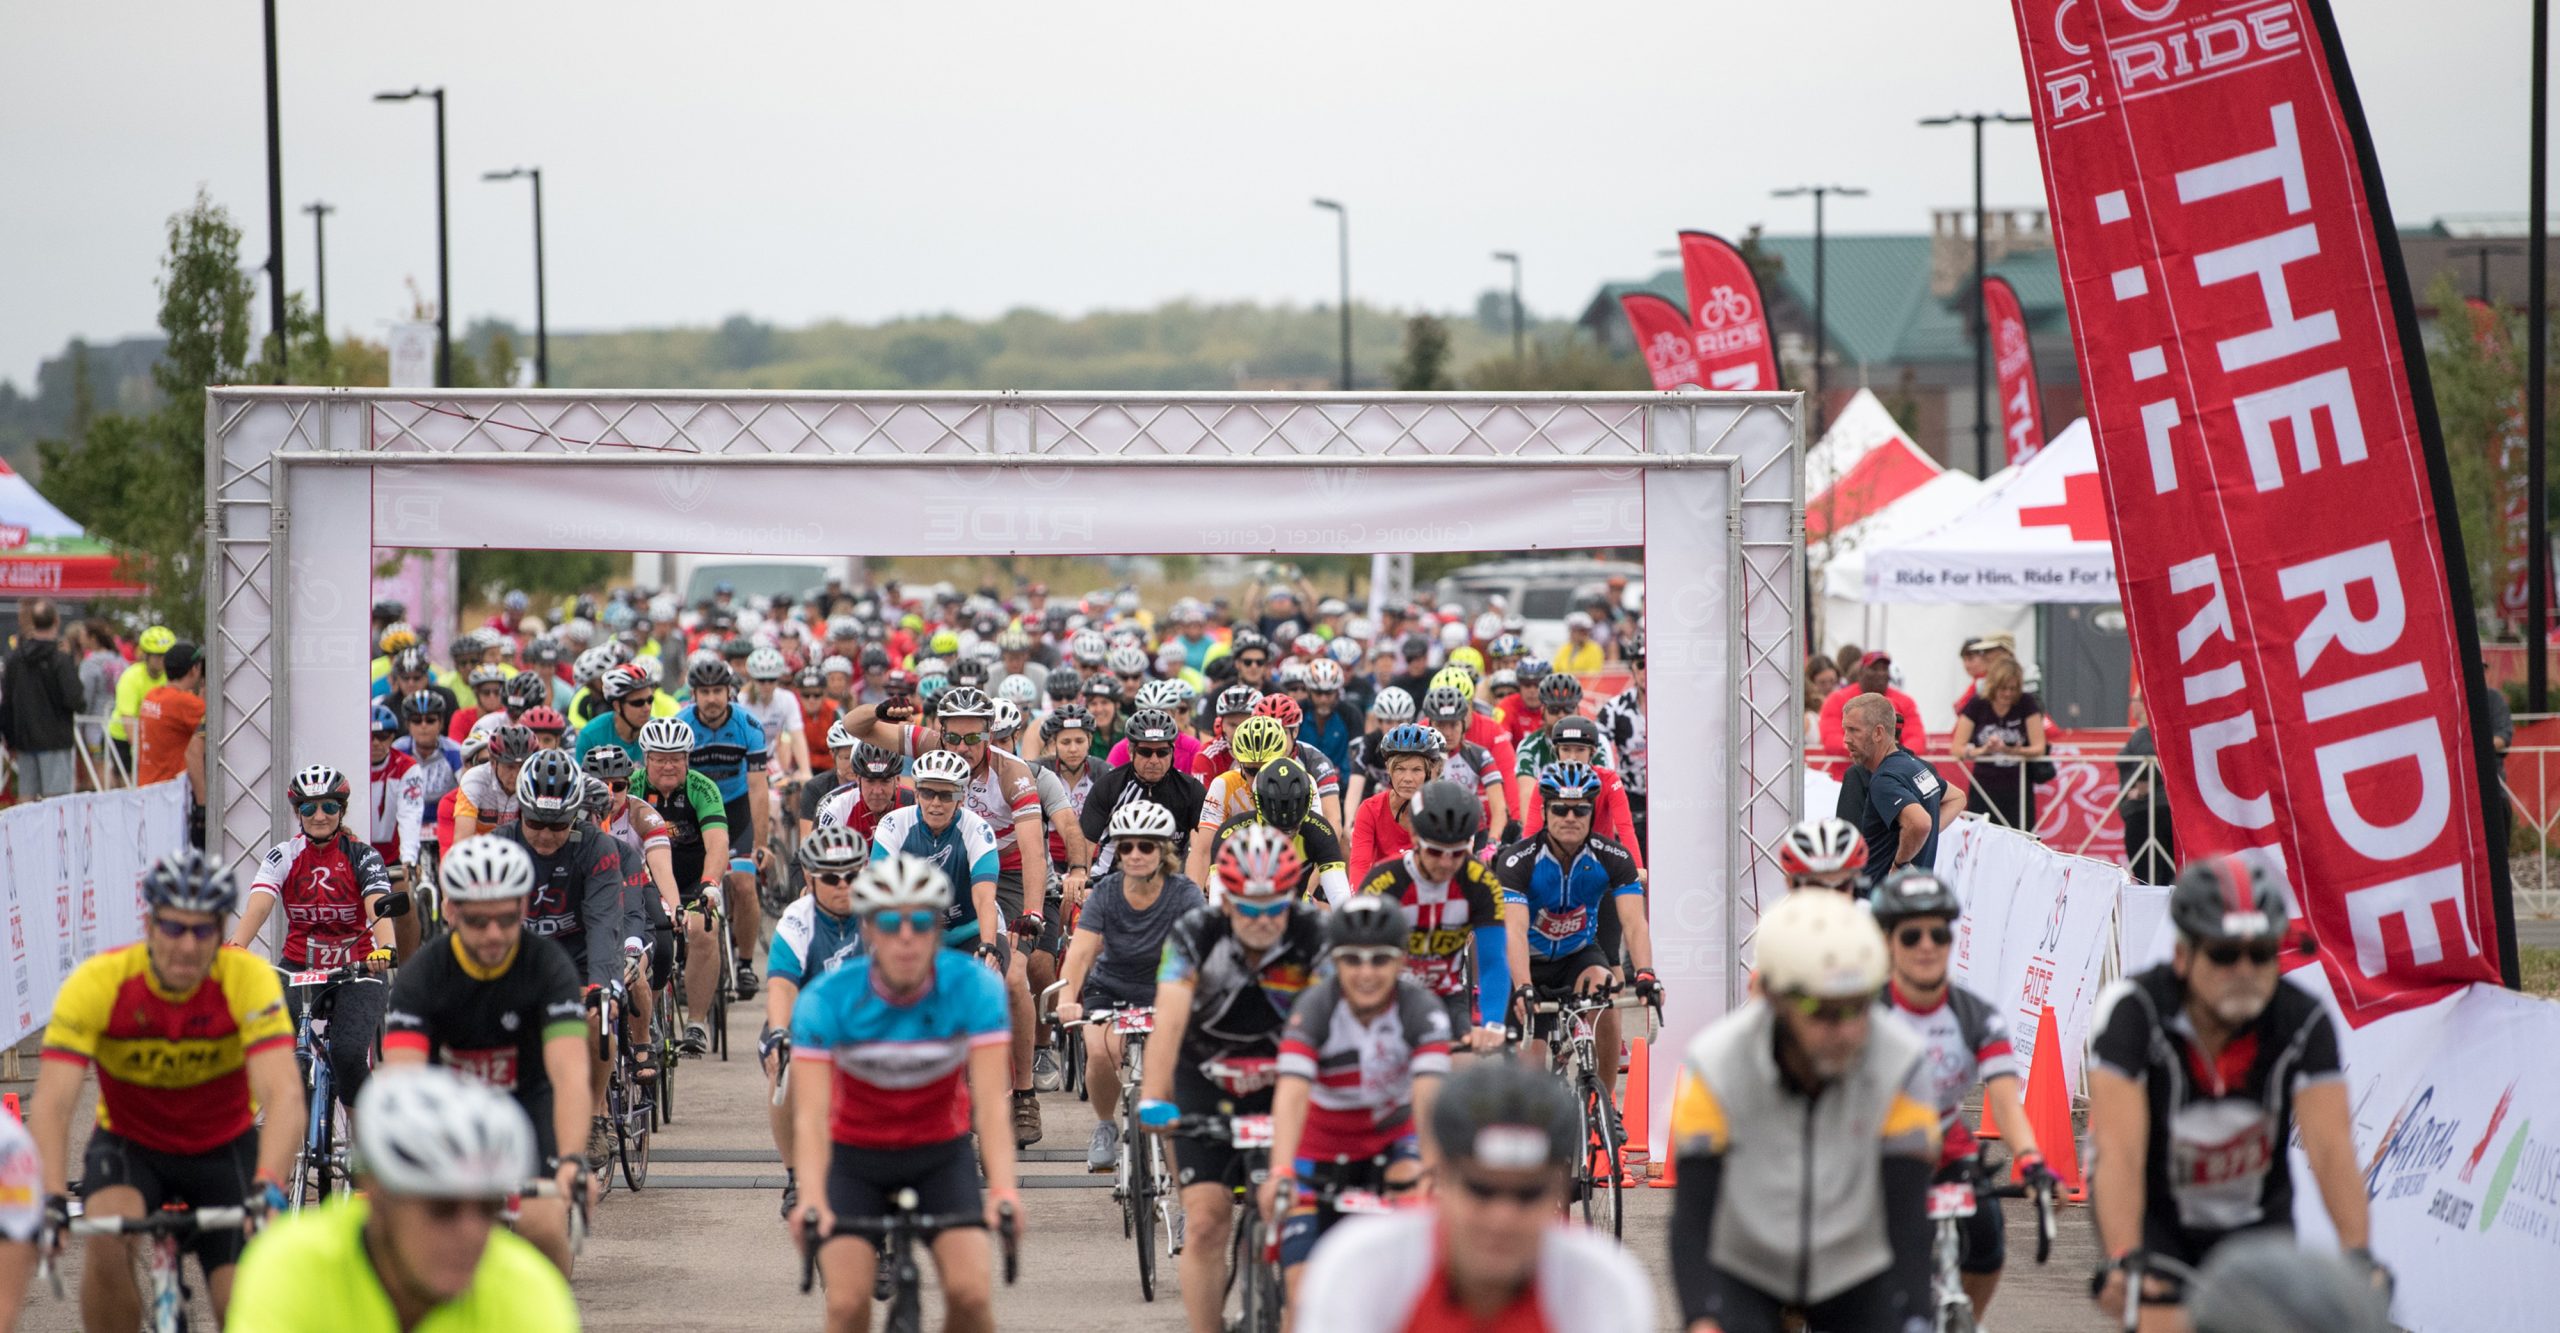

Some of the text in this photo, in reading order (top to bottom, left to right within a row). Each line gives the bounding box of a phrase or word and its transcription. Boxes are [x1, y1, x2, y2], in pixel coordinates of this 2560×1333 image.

[2112, 2, 2300, 89] RIDE
[1695, 322, 1762, 354] RIDE
[2175, 101, 2480, 979] THE RIDE
[1895, 568, 1935, 586] Ride
[1941, 568, 1971, 586] For
[1977, 568, 2018, 587] Him,
[2024, 567, 2064, 585] Ride
[2070, 566, 2099, 584] For
[288, 906, 358, 922] RIDE
[1548, 917, 1582, 935] 385
[320, 948, 351, 965] 271
